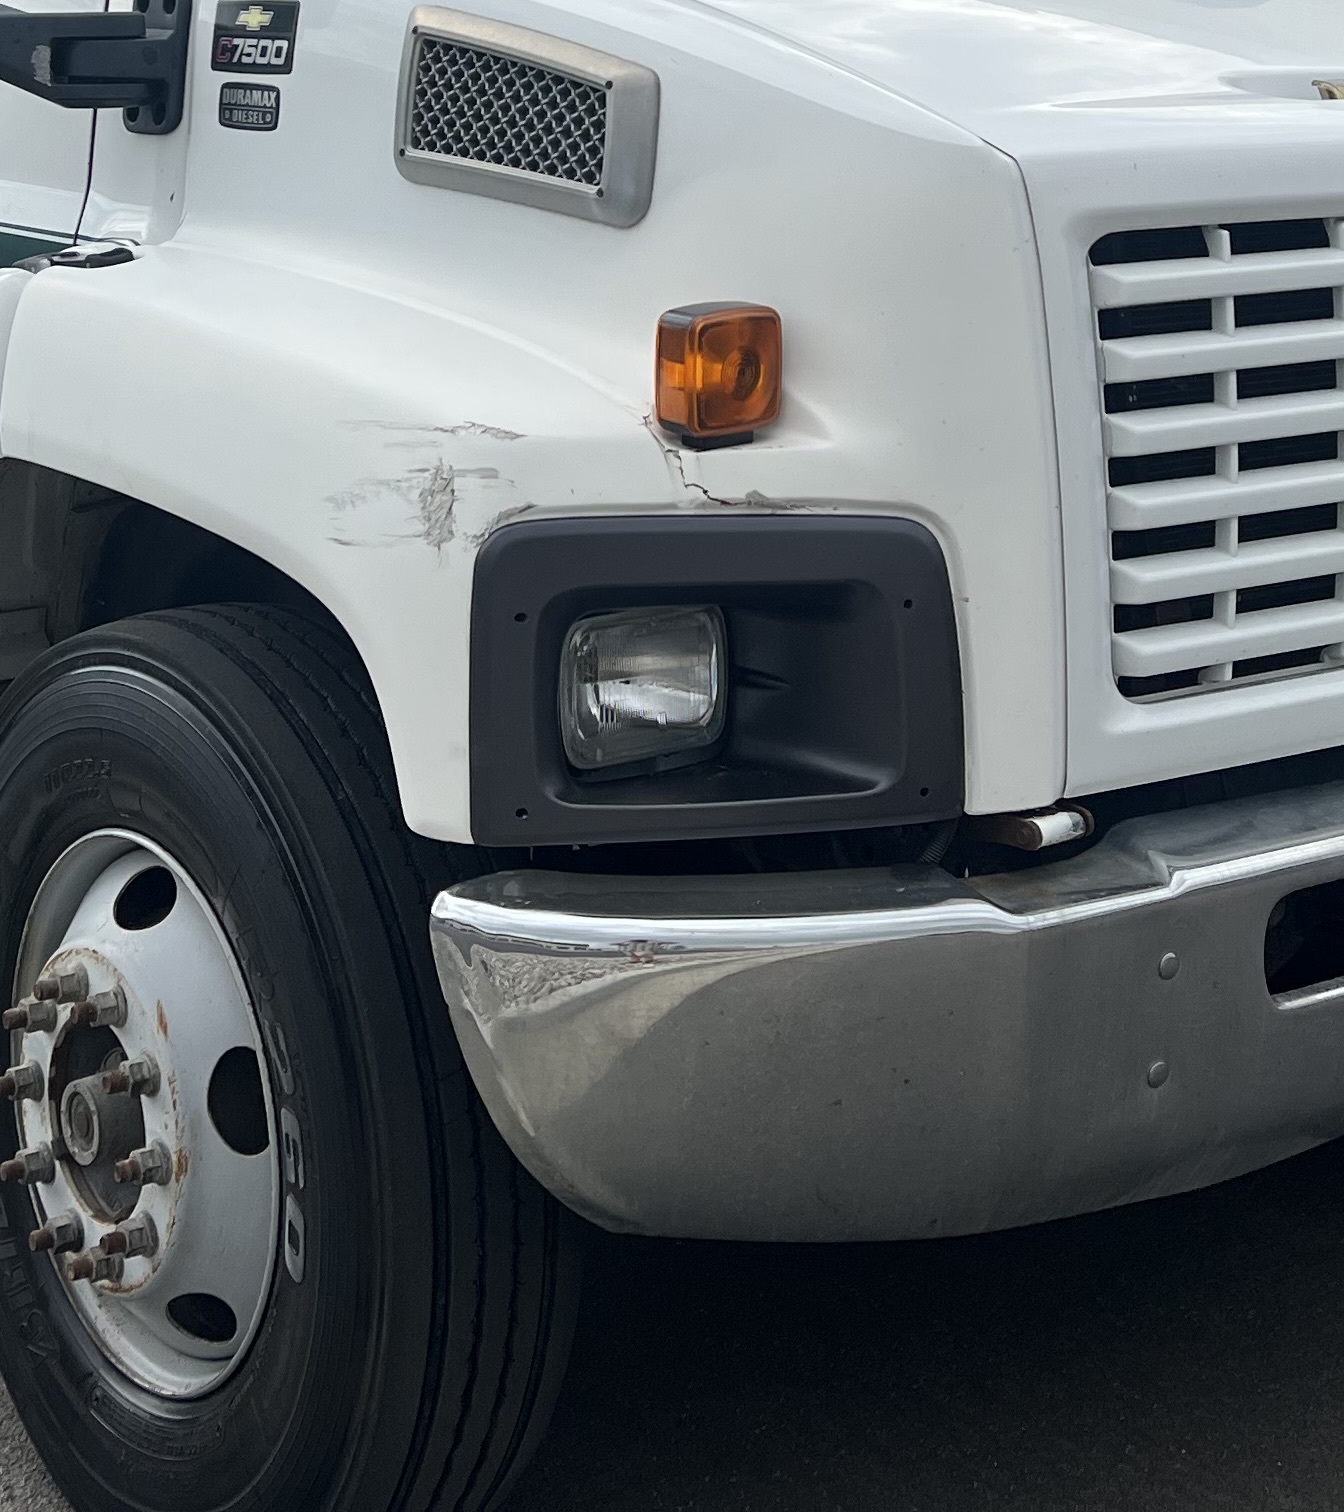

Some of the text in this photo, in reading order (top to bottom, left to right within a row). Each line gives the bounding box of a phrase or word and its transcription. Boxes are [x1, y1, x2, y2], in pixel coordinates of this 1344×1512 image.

[216, 37, 288, 65] C7500
[222, 88, 277, 108] DURAMAX
[232, 109, 264, 124] DIESEL
